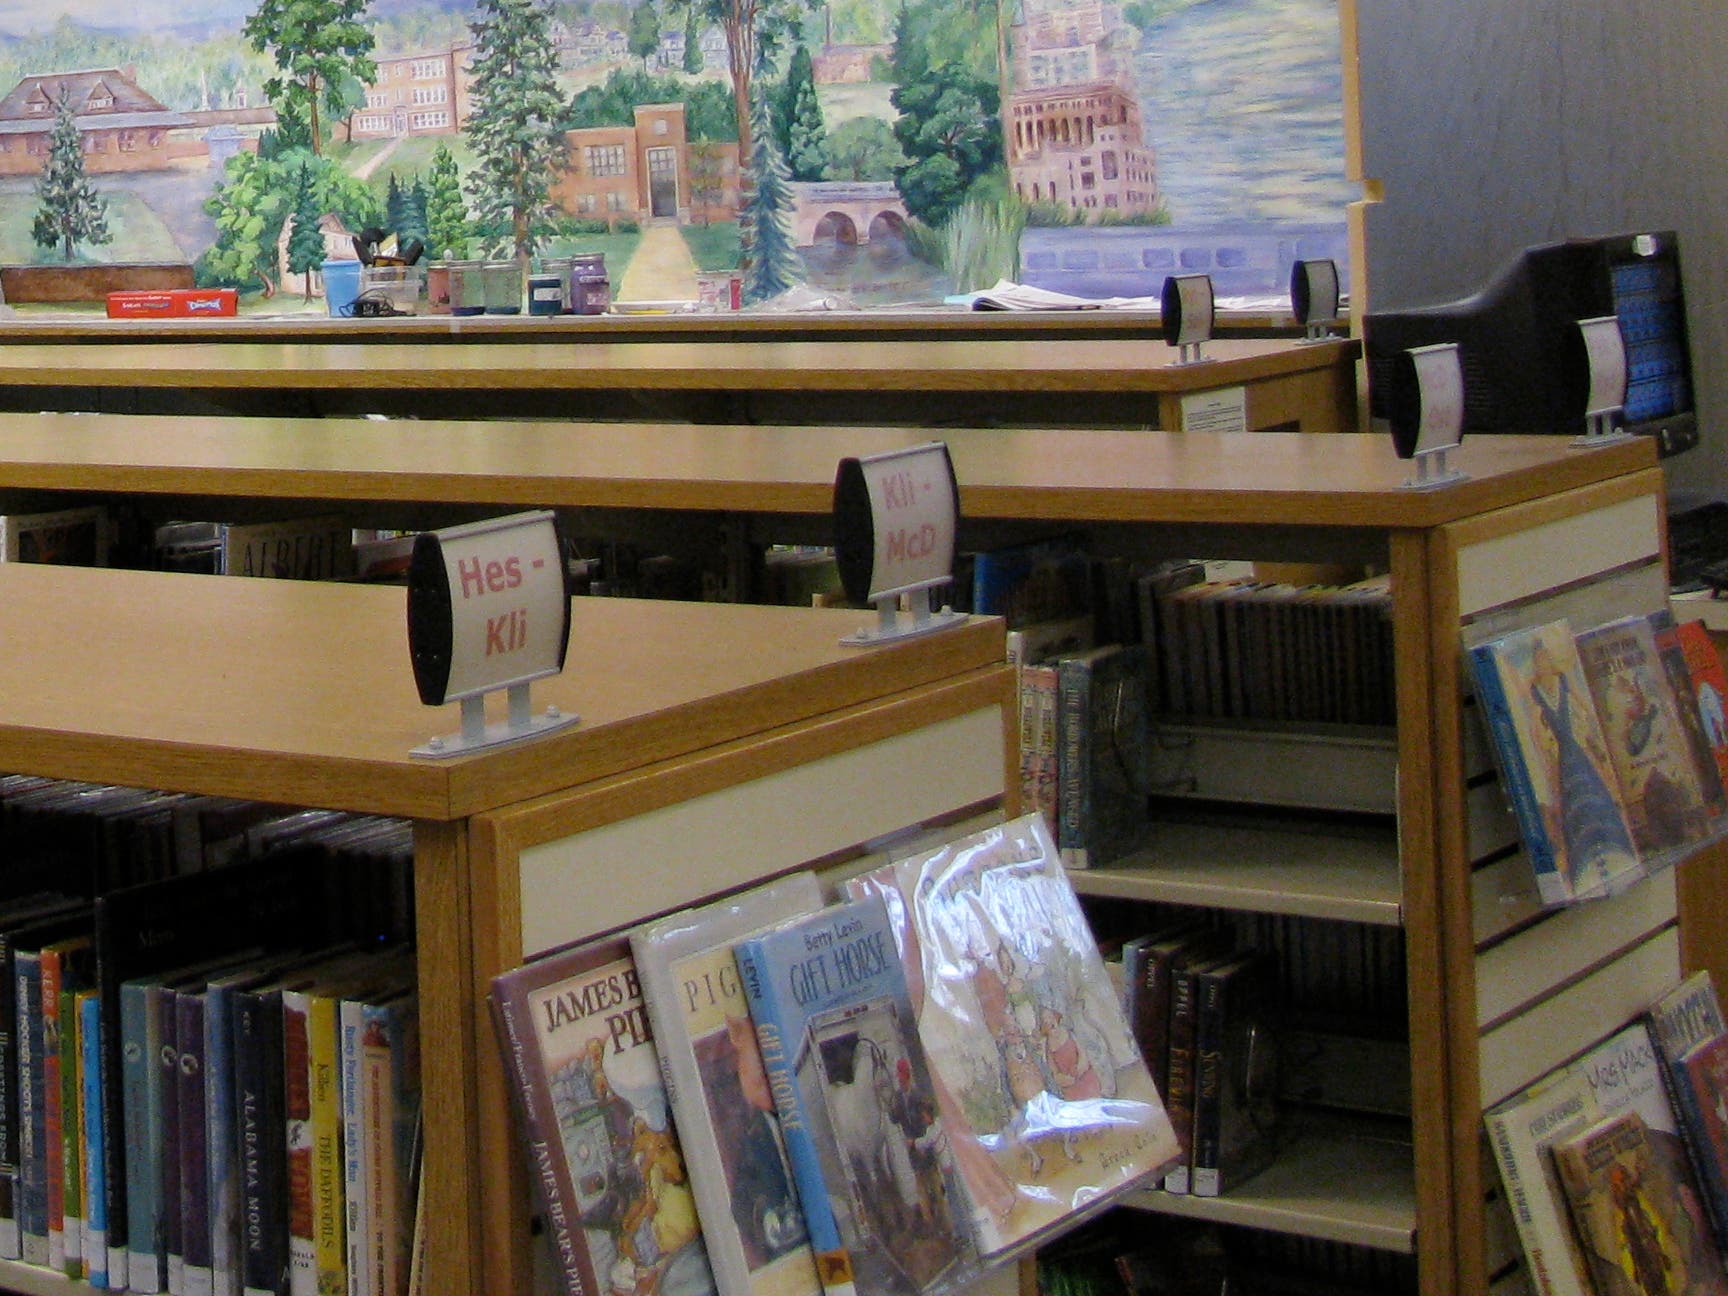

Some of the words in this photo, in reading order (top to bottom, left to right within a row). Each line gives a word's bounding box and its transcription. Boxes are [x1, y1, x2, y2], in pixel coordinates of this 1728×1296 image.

[881, 470, 917, 511] Kli
[886, 522, 937, 566] McD
[457, 554, 523, 600] Hes
[531, 558, 545, 569] -
[485, 606, 529, 658] Kli
[802, 930, 834, 954] Betty
[834, 916, 864, 940] Levin
[42, 968, 55, 1010] KERR
[789, 954, 833, 1007] GIFT
[832, 930, 892, 990] HORSE
[542, 974, 624, 1033] JAMES
[1175, 978, 1190, 1018] OPPEL
[741, 957, 764, 1001] LEVIN
[757, 1021, 784, 1064] GIFT
[771, 1068, 805, 1131] HORSE
[243, 1089, 260, 1190] ALABAMA
[319, 1135, 333, 1165] THE
[248, 1195, 262, 1254] MOON
[319, 1167, 336, 1250] DAFFODILS
[533, 1139, 562, 1198] JAMES
[548, 1201, 577, 1264] BEAR'S
